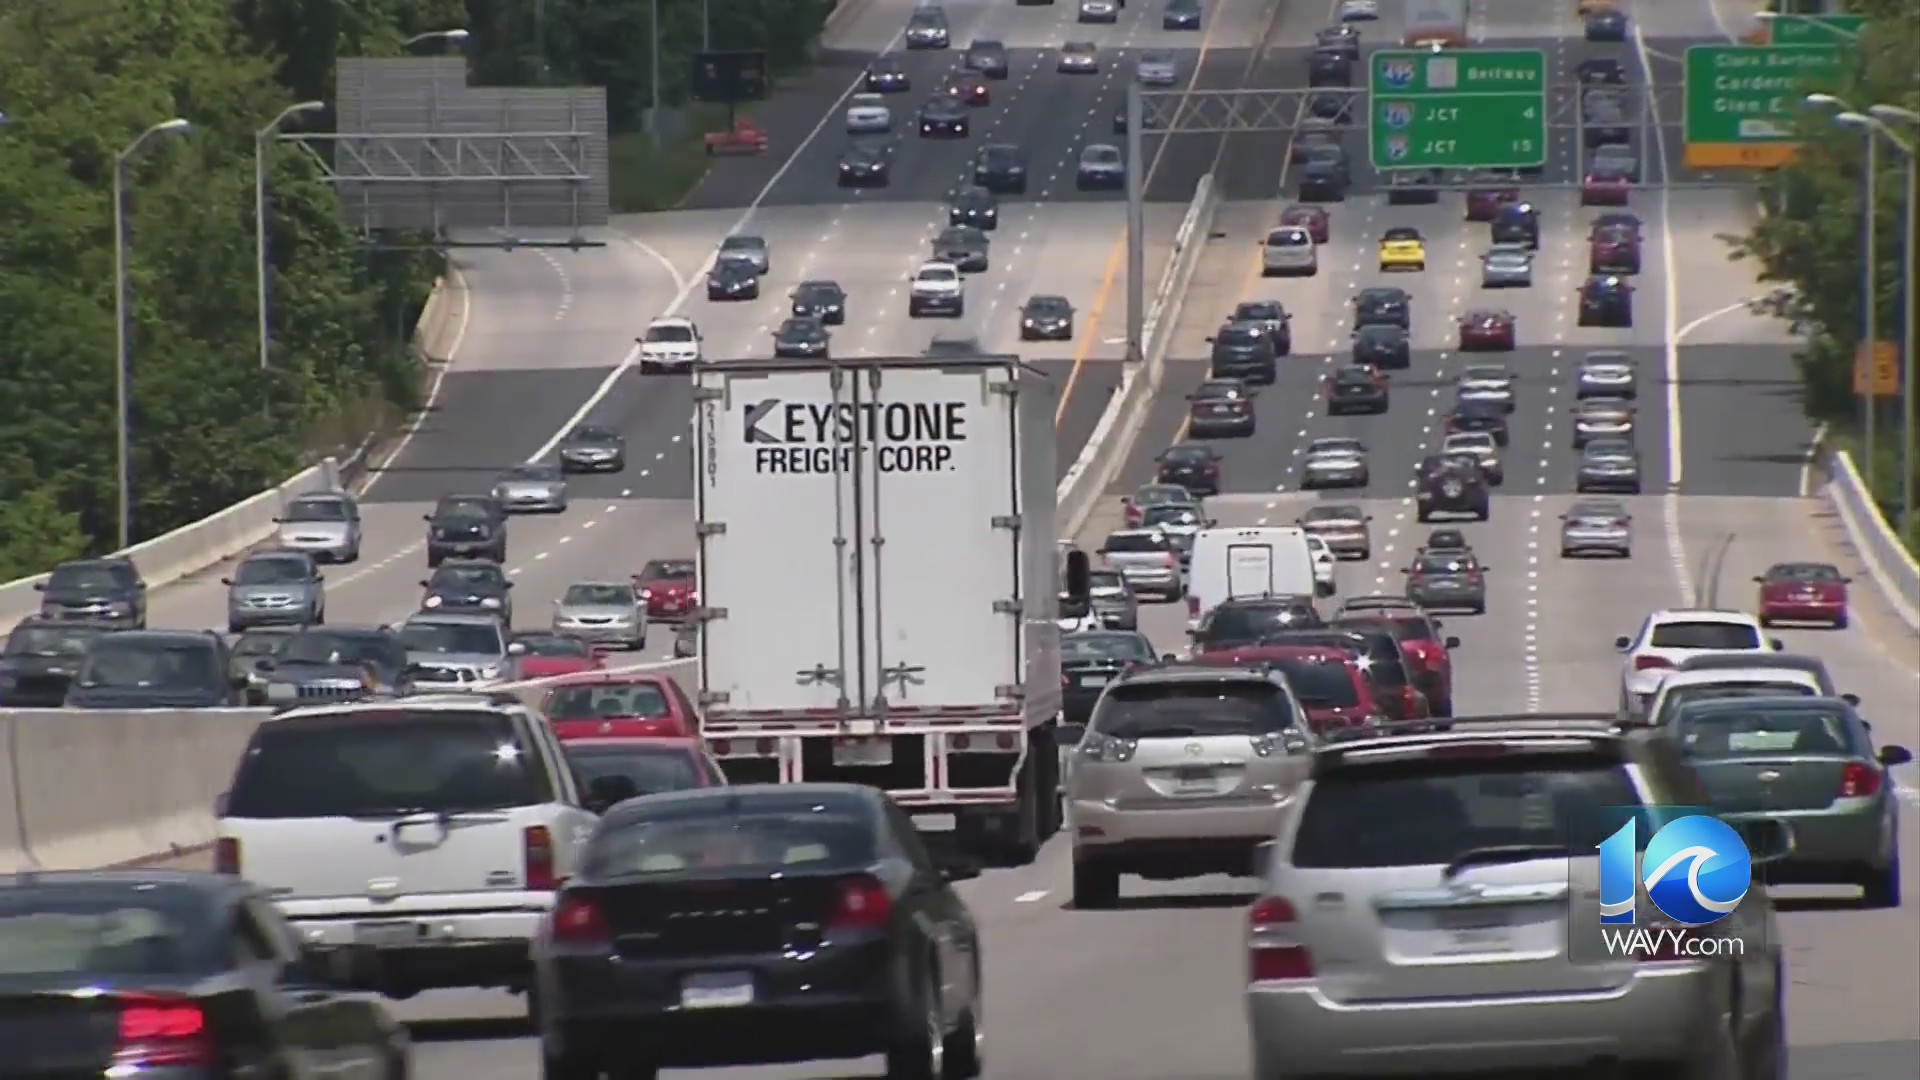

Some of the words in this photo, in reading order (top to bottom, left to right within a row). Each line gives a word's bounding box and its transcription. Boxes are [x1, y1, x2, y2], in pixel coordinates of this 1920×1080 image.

[1426, 107, 1460, 121] JCT
[1522, 107, 1535, 119] 4
[1424, 139, 1458, 154] JCT
[744, 398, 967, 444] KEYSTONE
[879, 445, 956, 473] CORP.
